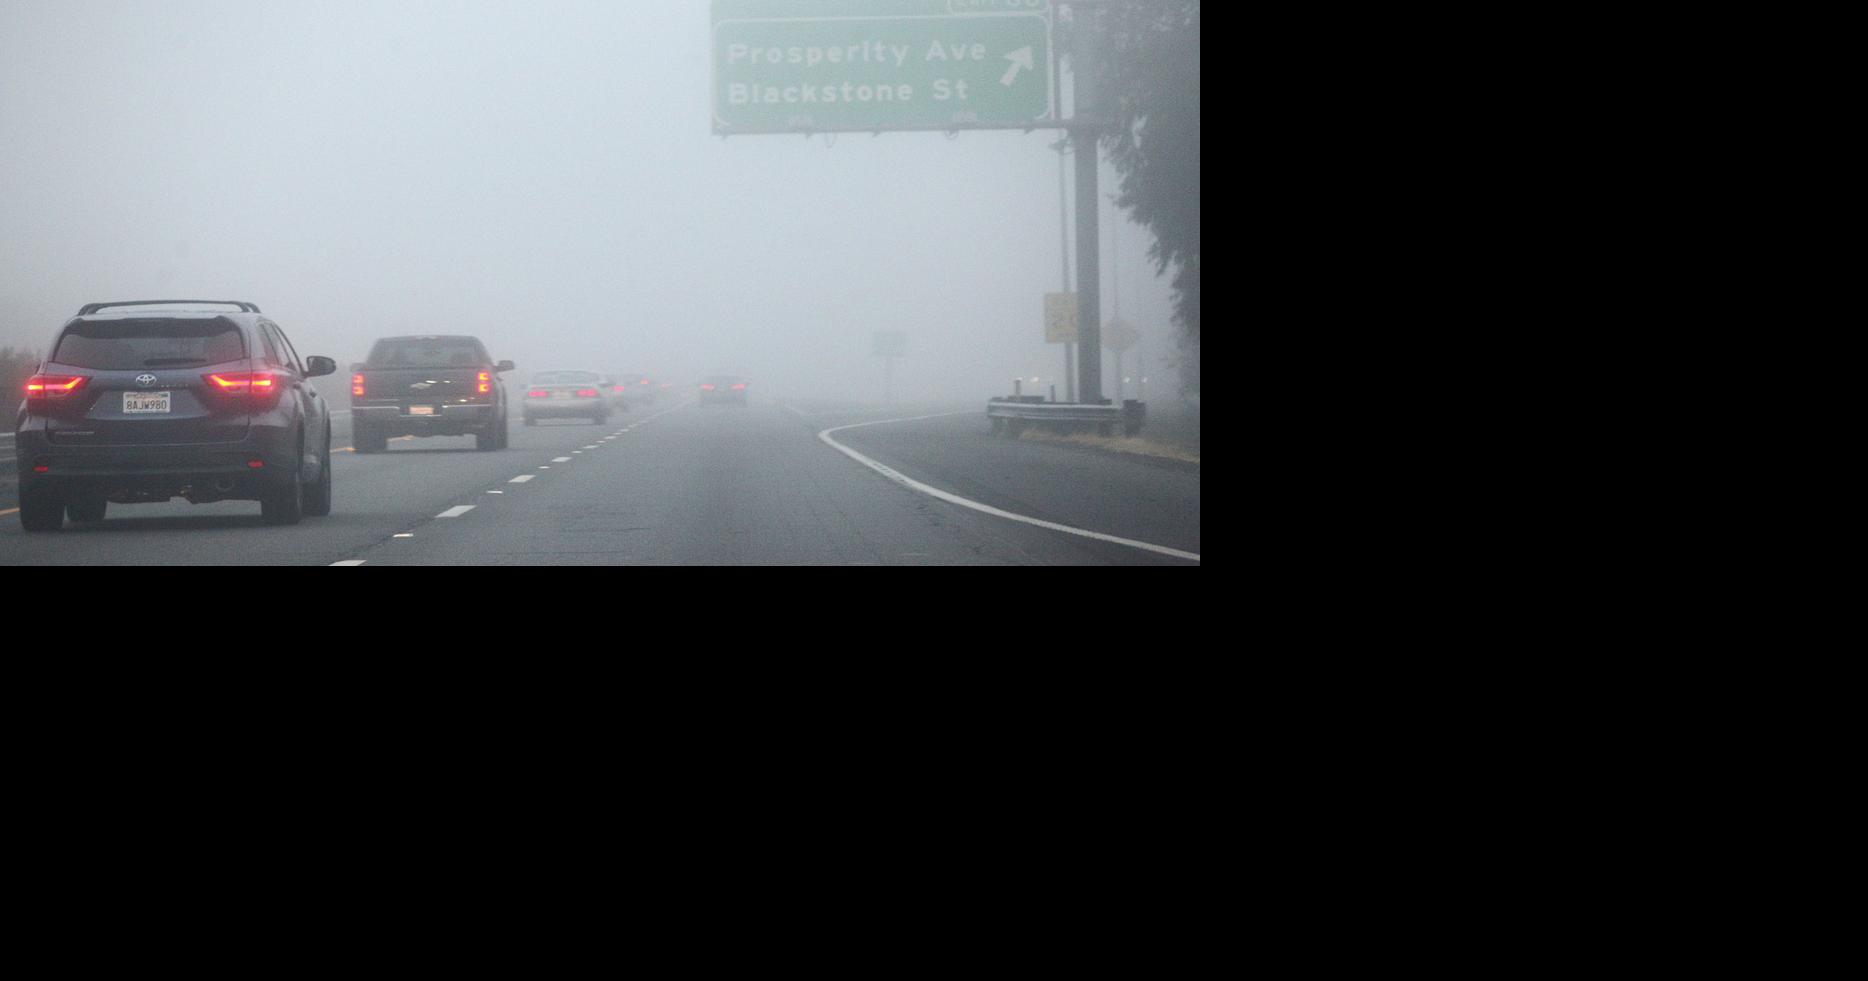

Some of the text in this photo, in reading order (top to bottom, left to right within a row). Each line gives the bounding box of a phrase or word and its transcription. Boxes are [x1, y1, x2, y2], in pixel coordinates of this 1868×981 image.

[728, 40, 986, 66] Prosperity Ave
[729, 79, 968, 104] Blackstone St
[126, 400, 167, 410] 8AJW980
